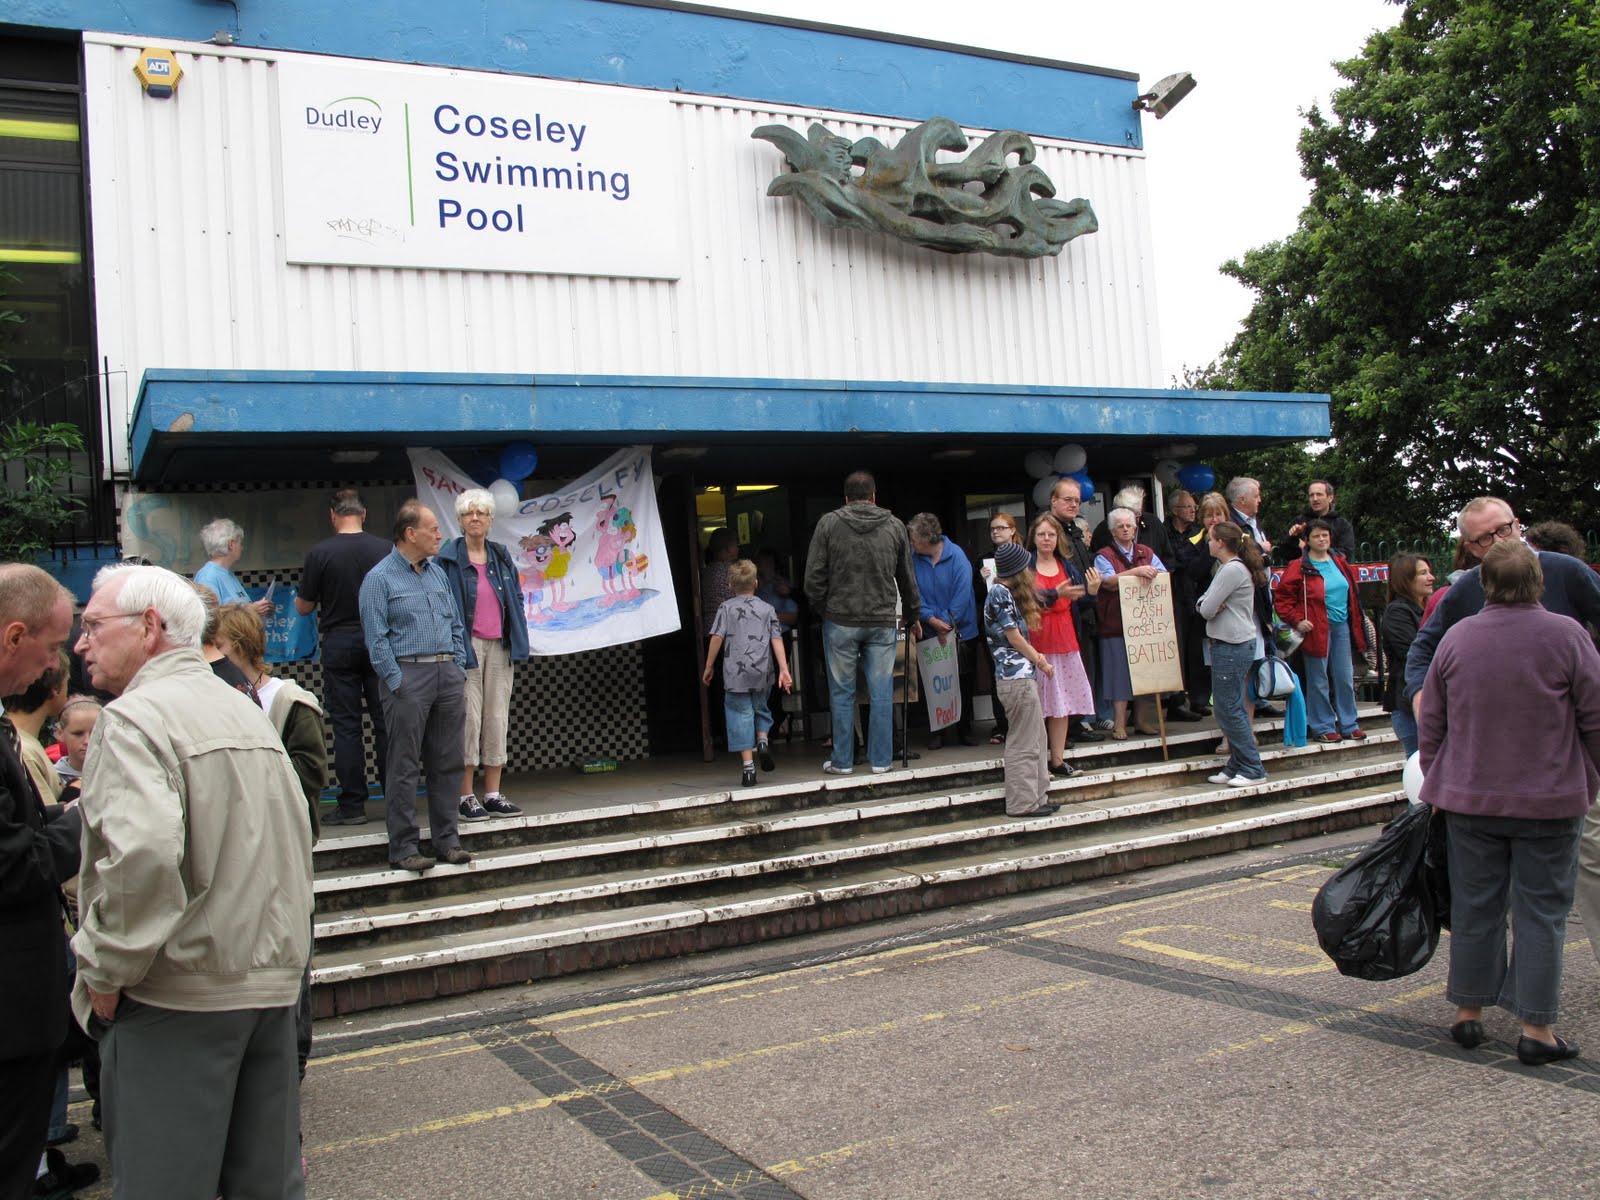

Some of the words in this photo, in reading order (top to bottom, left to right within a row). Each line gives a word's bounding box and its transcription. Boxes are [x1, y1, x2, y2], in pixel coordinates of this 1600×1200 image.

[148, 61, 169, 72] ADT
[306, 106, 382, 134] Dudley
[433, 104, 587, 152] Coseley
[435, 151, 630, 201] Swimming
[438, 199, 524, 233] Pool
[422, 466, 467, 496] SAV
[519, 455, 645, 515] COSELEY
[1358, 566, 1389, 582] BAT
[1124, 583, 1167, 600] SPLASH
[1137, 596, 1155, 606] THE
[1132, 604, 1163, 619] CASH
[1127, 621, 1170, 638] COSELEY
[1127, 640, 1176, 665] BATHS
